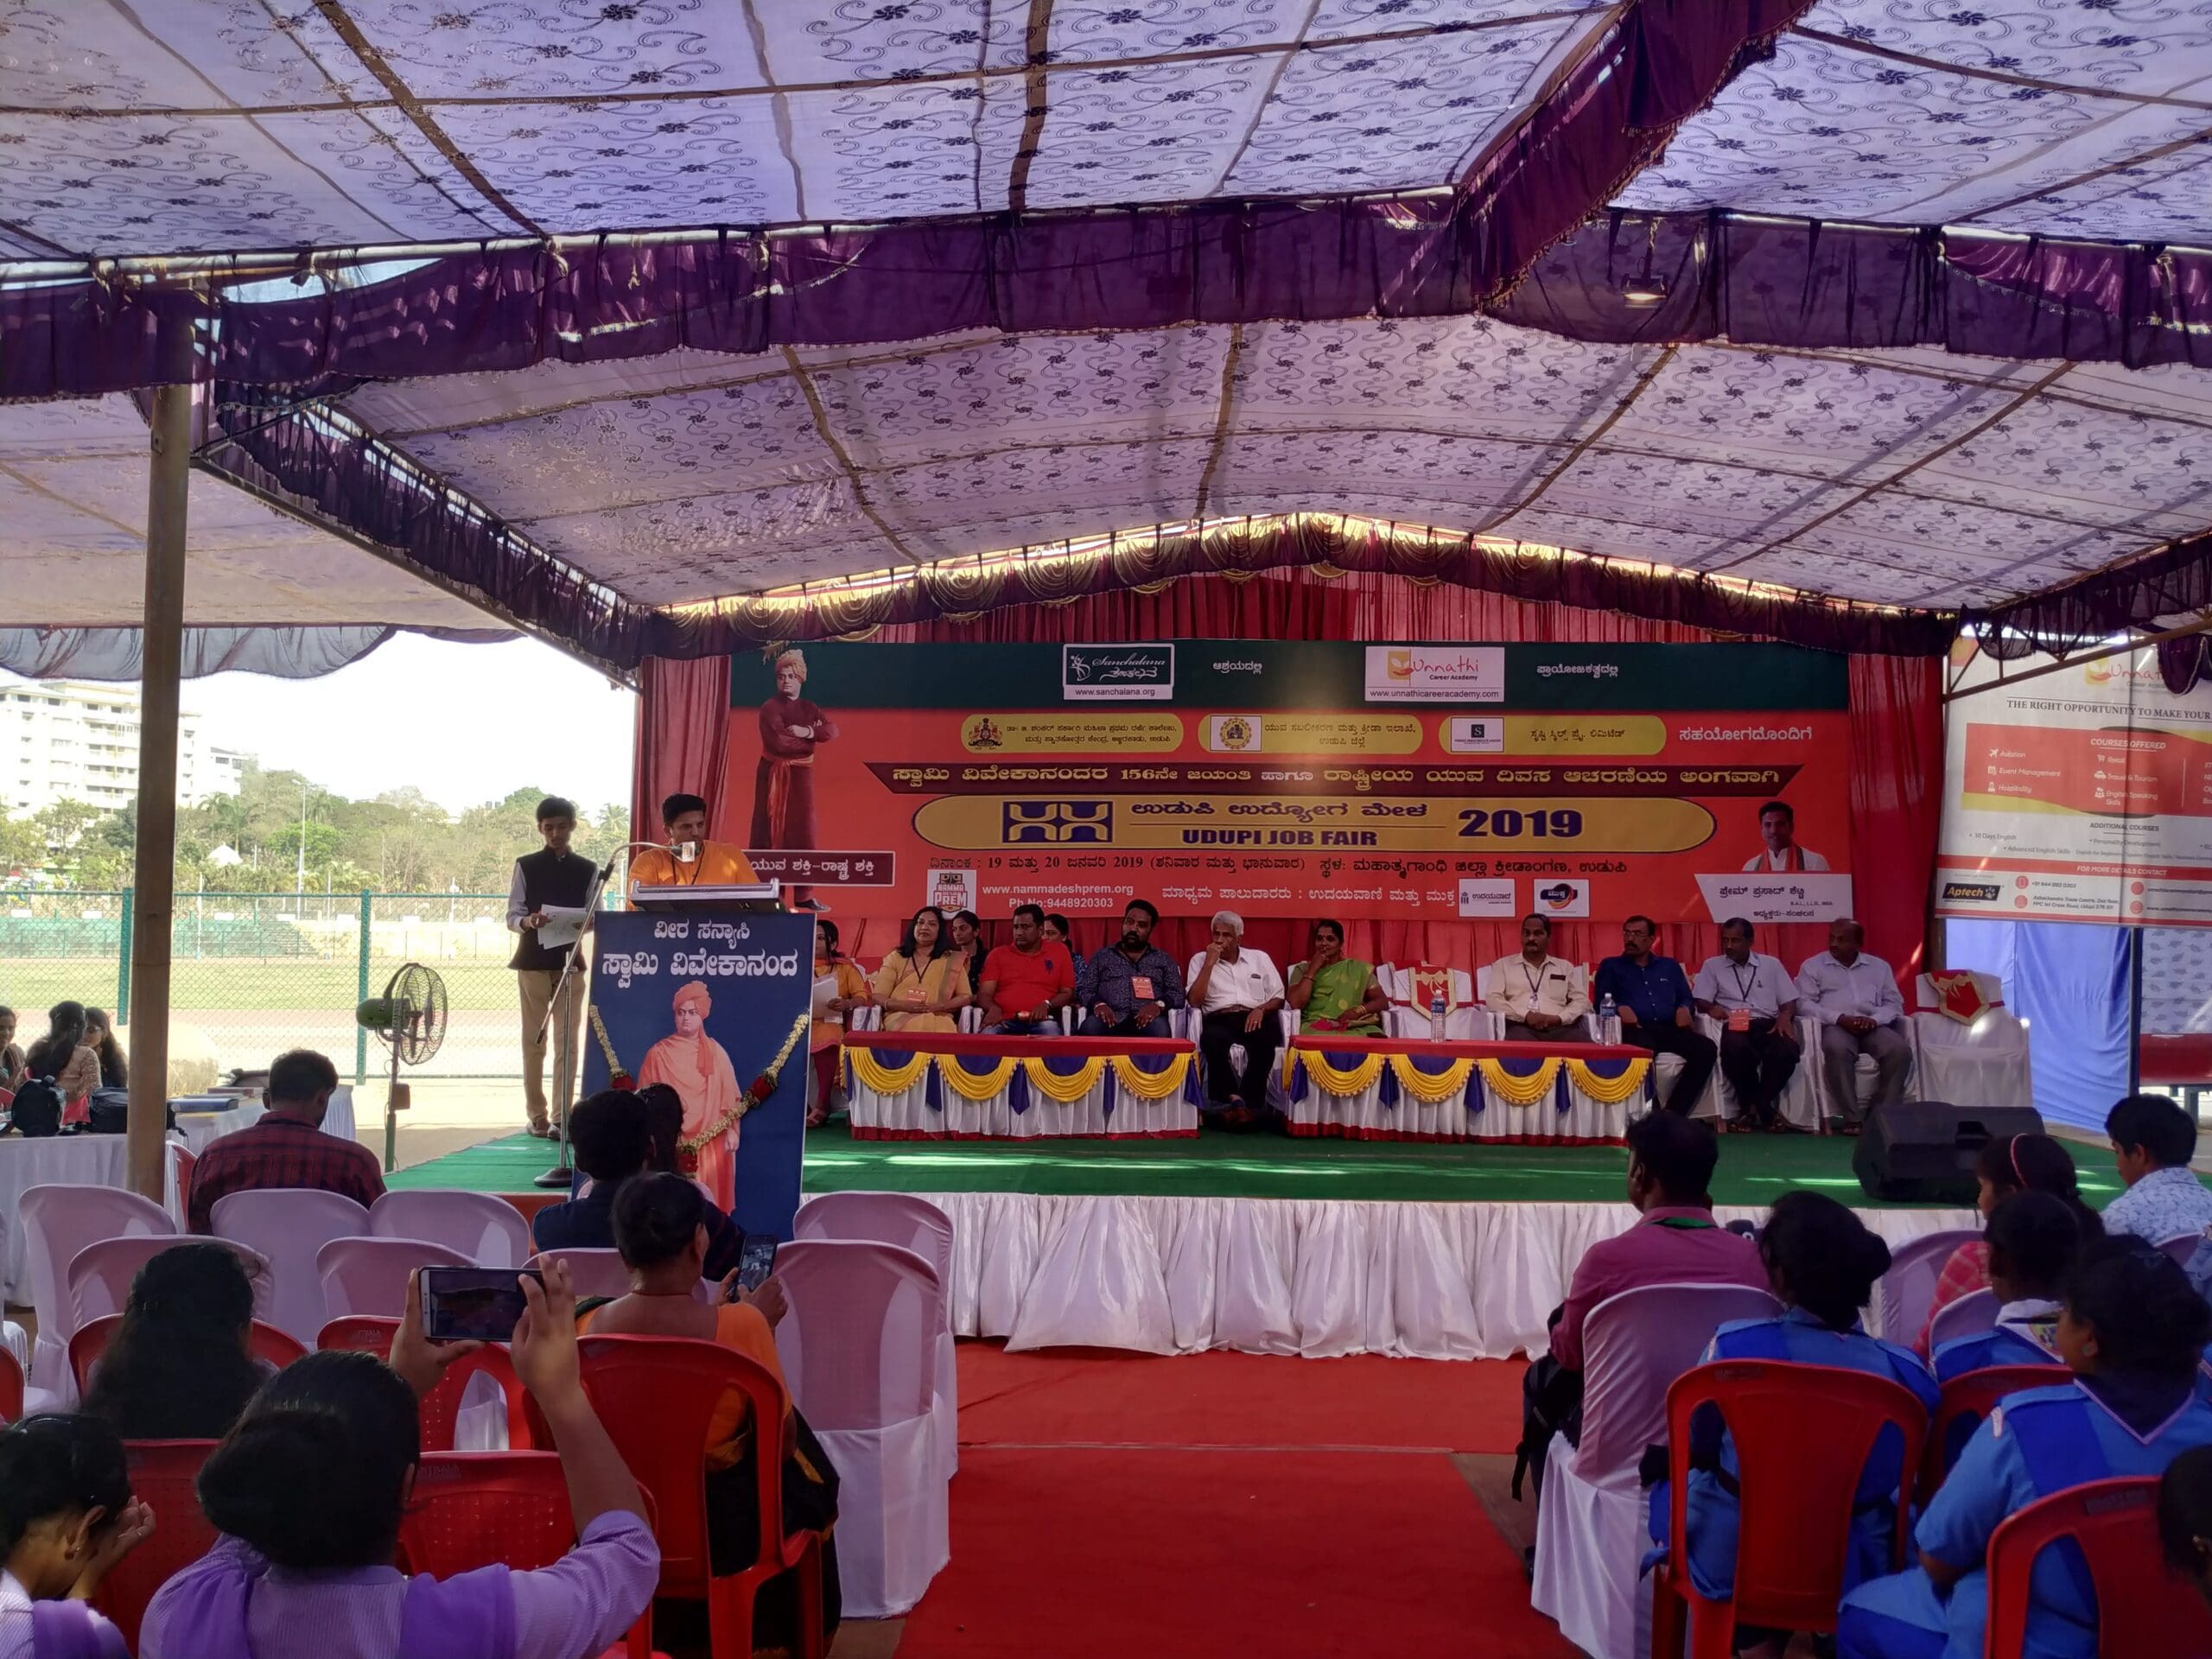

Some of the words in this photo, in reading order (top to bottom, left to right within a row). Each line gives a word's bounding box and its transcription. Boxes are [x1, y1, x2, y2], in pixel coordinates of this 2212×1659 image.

[1092, 652, 1166, 666] Sanchalana
[1413, 655, 1479, 673] Unnathi
[1213, 660, 1263, 674] ಆಶ್ರಯದಲ್ಲಿ
[1075, 688, 1155, 696] www.sanchalana.org
[1370, 690, 1499, 700] www.unnathicareeracademy.com
[2006, 700, 2027, 709] THE
[2030, 702, 2063, 711] RIGHT
[2064, 703, 2137, 715] OPPORTUNITY
[2153, 709, 2181, 718] MAKE
[2183, 710, 2211, 720] YOUR
[1265, 724, 1287, 733] ಯುವ
[1338, 724, 1358, 734] ಮತ್ತು
[1361, 724, 1382, 734] ಕ್ರೀಡಾ
[1679, 727, 1812, 741] ಸಹಯೋಗದೊಂದಿಗೆ
[2090, 738, 2128, 747] COURSES
[2130, 741, 2166, 749] OFFERED
[893, 767, 950, 787] ಸ್ವಾಮಿ
[962, 765, 1108, 781] ವಿವೇಕಾನಂದರ
[1121, 767, 1178, 780] 156ನೇ
[1187, 769, 1251, 780] ಜಯಂತಿ
[1261, 771, 1313, 781] ಹಾಗೂ
[1323, 769, 1414, 791] ರಾಷ್ಟ್ರೀಯ
[1426, 769, 1484, 782] ಯುವ
[1497, 769, 1551, 783] ದಿವಸ
[1563, 766, 1667, 783] ಆಚರಣೆಯ
[1680, 770, 1778, 783] ಅಂಗವಾಗಿ
[1131, 801, 1215, 815] ಉಡುಪಿ
[1228, 803, 1348, 823] ಉದ್ಯೋಗ
[1362, 802, 1428, 817] ಮೇಳ
[1458, 810, 1582, 837] 2019
[1182, 830, 1262, 845] UDUPI
[1268, 830, 1314, 845] JOB
[1320, 831, 1377, 846] FAIR
[751, 858, 786, 870] ಯುವ
[855, 858, 874, 875] ಶಕ್ತಿ
[930, 857, 971, 868] ದಿನಾಂಕ
[988, 856, 1002, 868] 19
[1009, 857, 1039, 873] ಮತ್ತು
[1046, 856, 1060, 868] 20
[1067, 856, 1107, 868] ಜನವರಿ
[1114, 856, 1143, 868] 2019
[1150, 856, 1199, 870] (ಶನಿವಾರ
[1206, 857, 1236, 874] ಮತ್ತು
[1243, 856, 1305, 871] ಭಾನುವಾರ)
[1455, 859, 1487, 878] ಜಿಲ್ಲಾ
[1580, 859, 1627, 873] ಉಡುಪಿ
[982, 884, 1134, 896] www.nammadeshprem.org
[1162, 886, 1212, 904] ಮಾಧ್ಯಮ
[1219, 887, 1292, 899] ಪಾಲುದಾರರು
[1309, 887, 1382, 900] ಉದಯವಾಣಿ
[1389, 889, 1421, 906] ಮತ್ತು
[1427, 889, 1455, 906] ಮುಕ್ತ
[1719, 886, 1748, 898] ಪ್ರೇಮ್
[1753, 886, 1784, 898] ಪ್ರಸಾದ್
[1947, 886, 1983, 897] Aptech
[933, 892, 967, 907] PREM
[654, 919, 690, 939] ವೀರ
[697, 920, 750, 950] ಸನ್ಯಾಸಿ
[602, 952, 658, 988] ಸ್ವಾಮಿ
[671, 948, 798, 976] ವಿವೇಕಾನಂದ
